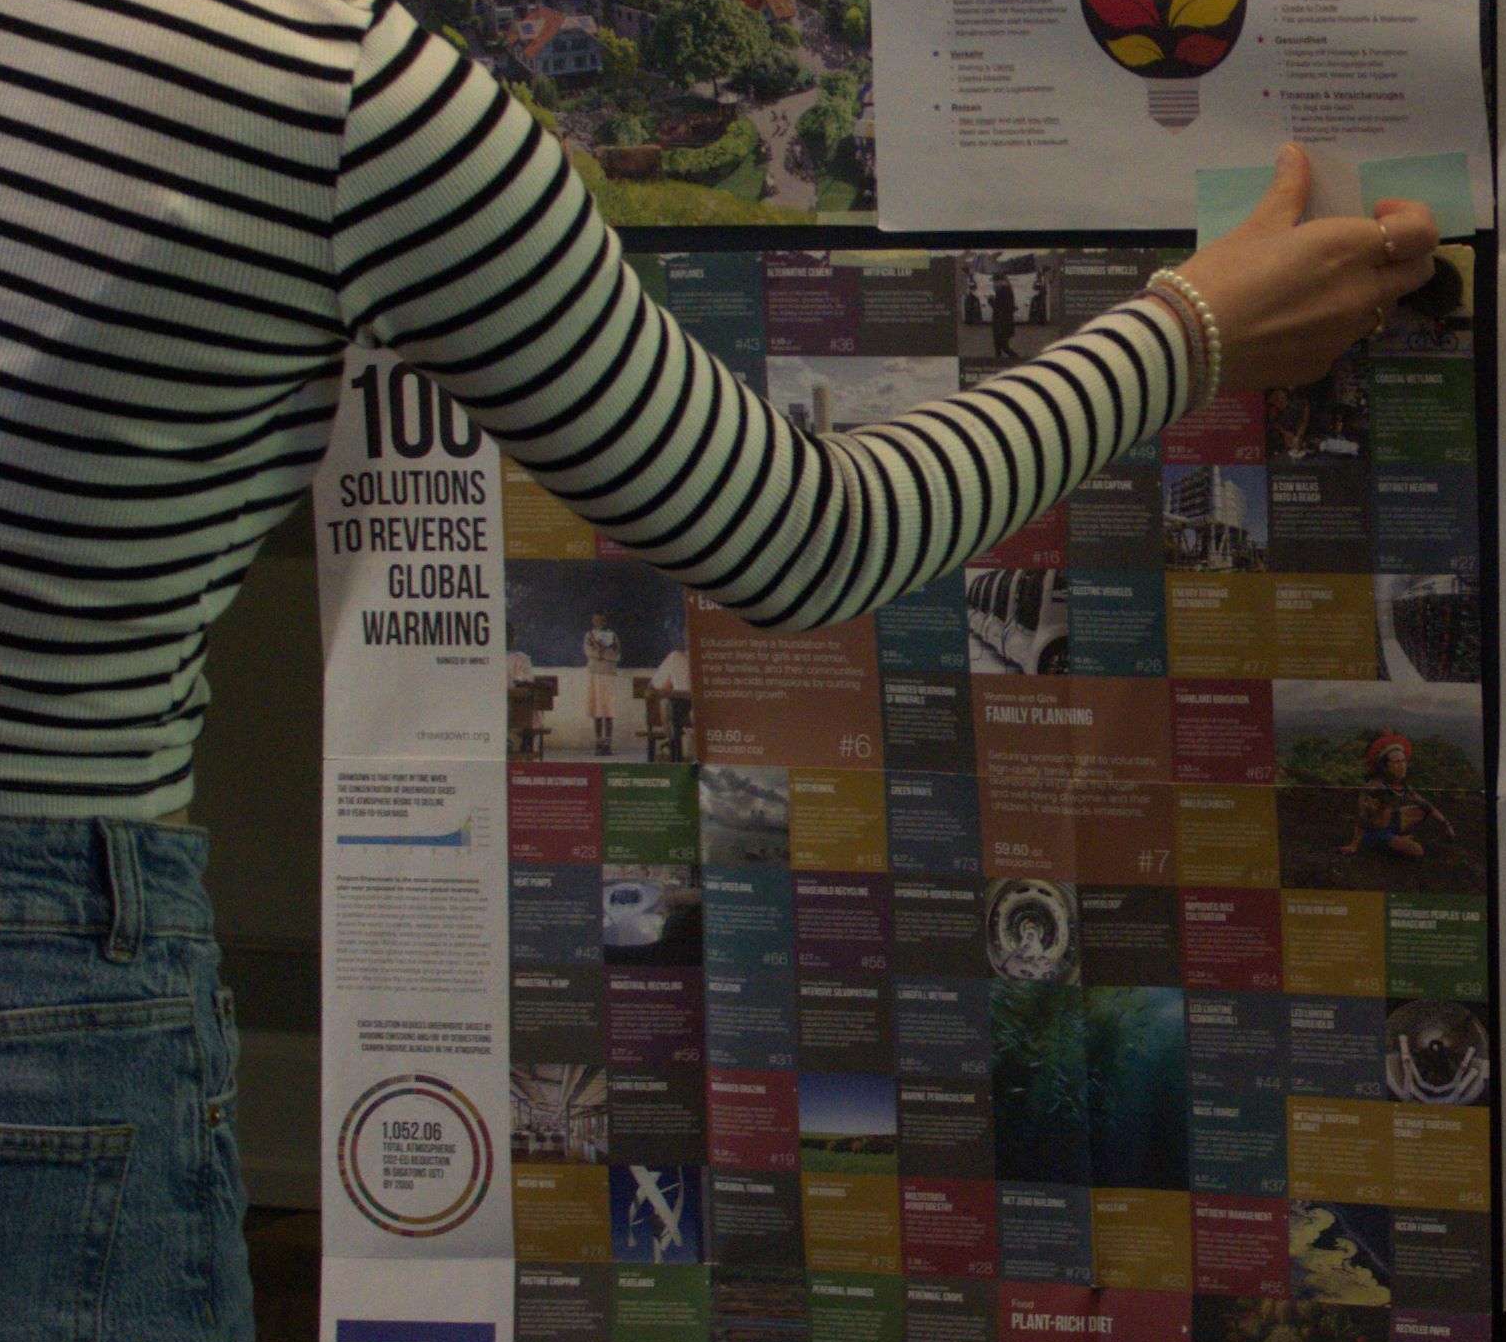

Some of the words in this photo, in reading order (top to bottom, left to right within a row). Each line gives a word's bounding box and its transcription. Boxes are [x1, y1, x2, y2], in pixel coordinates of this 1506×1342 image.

[351, 364, 482, 459] 100
[340, 470, 486, 507] SOLUTIONS
[327, 519, 361, 554] TO
[371, 517, 487, 551] REVERSE
[389, 564, 490, 599] GLOBAL
[363, 611, 490, 646] WARMING
[985, 706, 1029, 724] FAMILY
[1031, 708, 1094, 726] PLANNING
[417, 729, 490, 743] drawdown.org
[839, 734, 872, 759] #6
[1138, 849, 1170, 874] #7
[1011, 1312, 1085, 1334] PLANT-RICH
[1088, 1315, 1113, 1334] DIET
